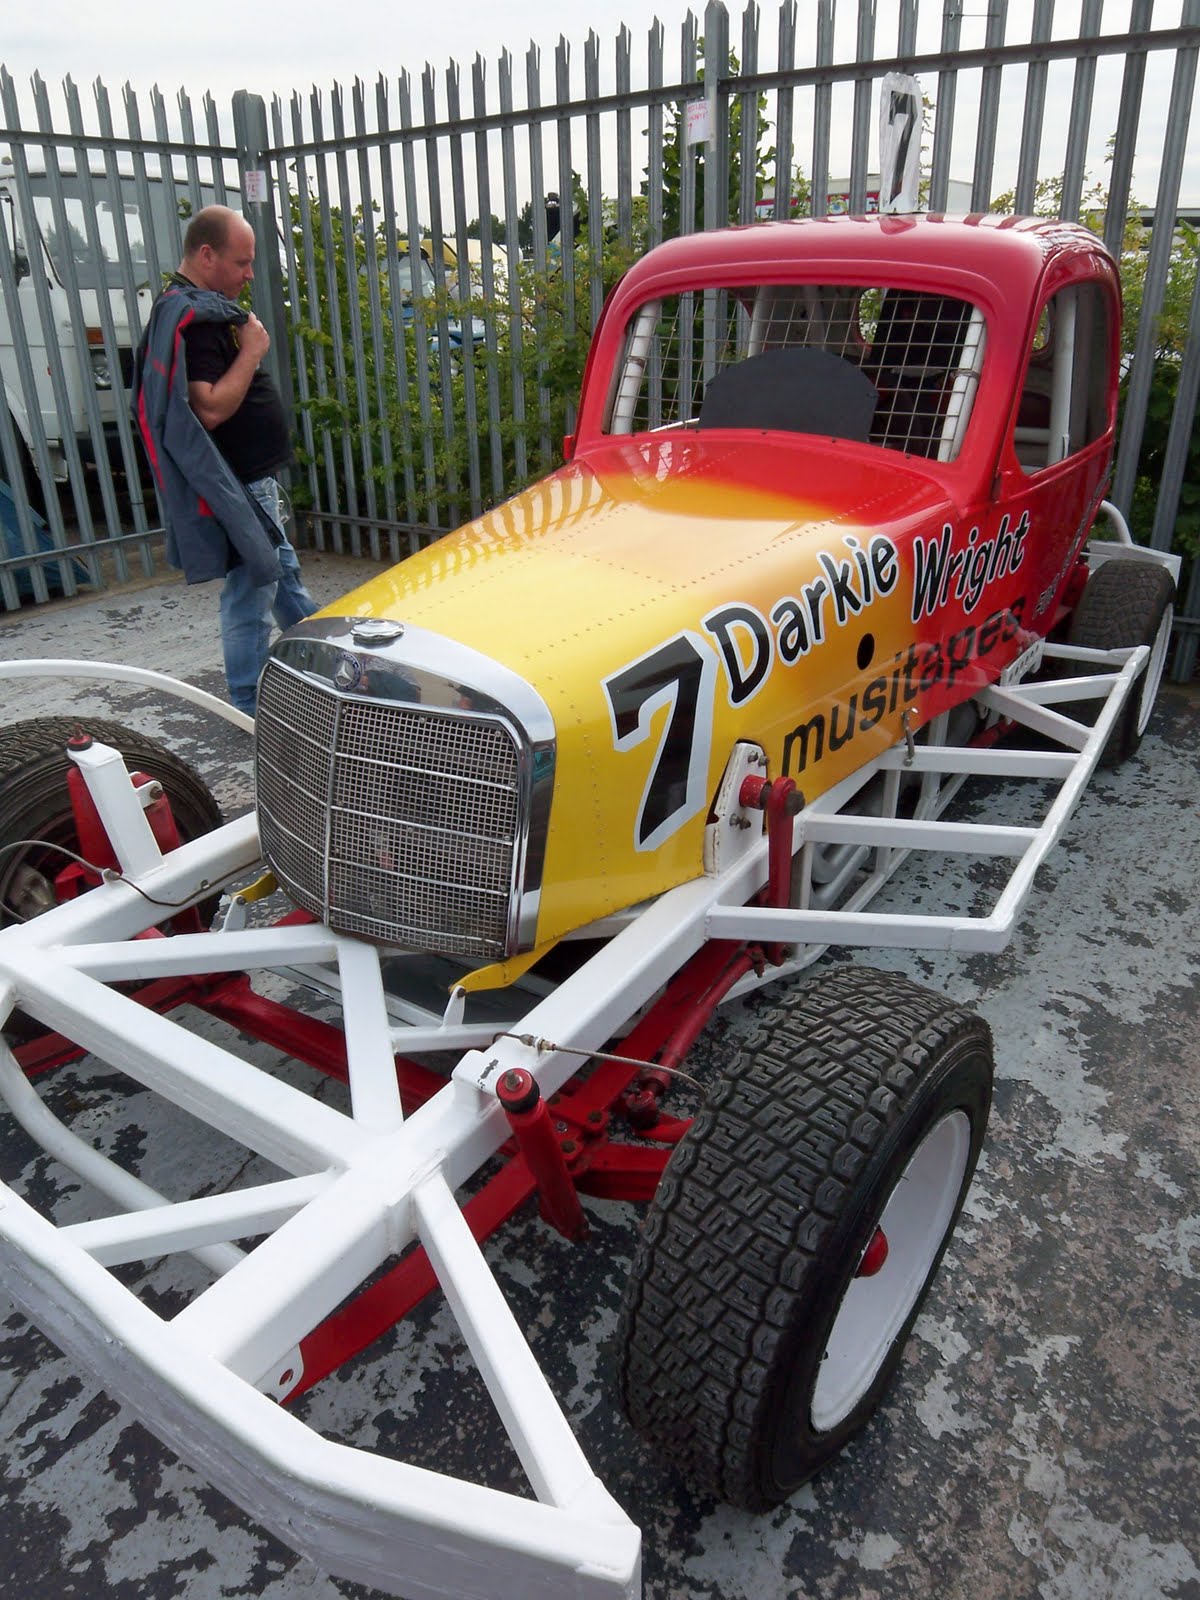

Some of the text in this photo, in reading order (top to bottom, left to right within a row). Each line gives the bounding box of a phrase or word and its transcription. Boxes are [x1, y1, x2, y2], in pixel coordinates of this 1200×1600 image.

[889, 90, 918, 205] 7
[702, 535, 898, 707] Darkie
[911, 509, 1030, 623] Wright
[781, 597, 1026, 778] musitapes
[601, 630, 719, 851] 7
